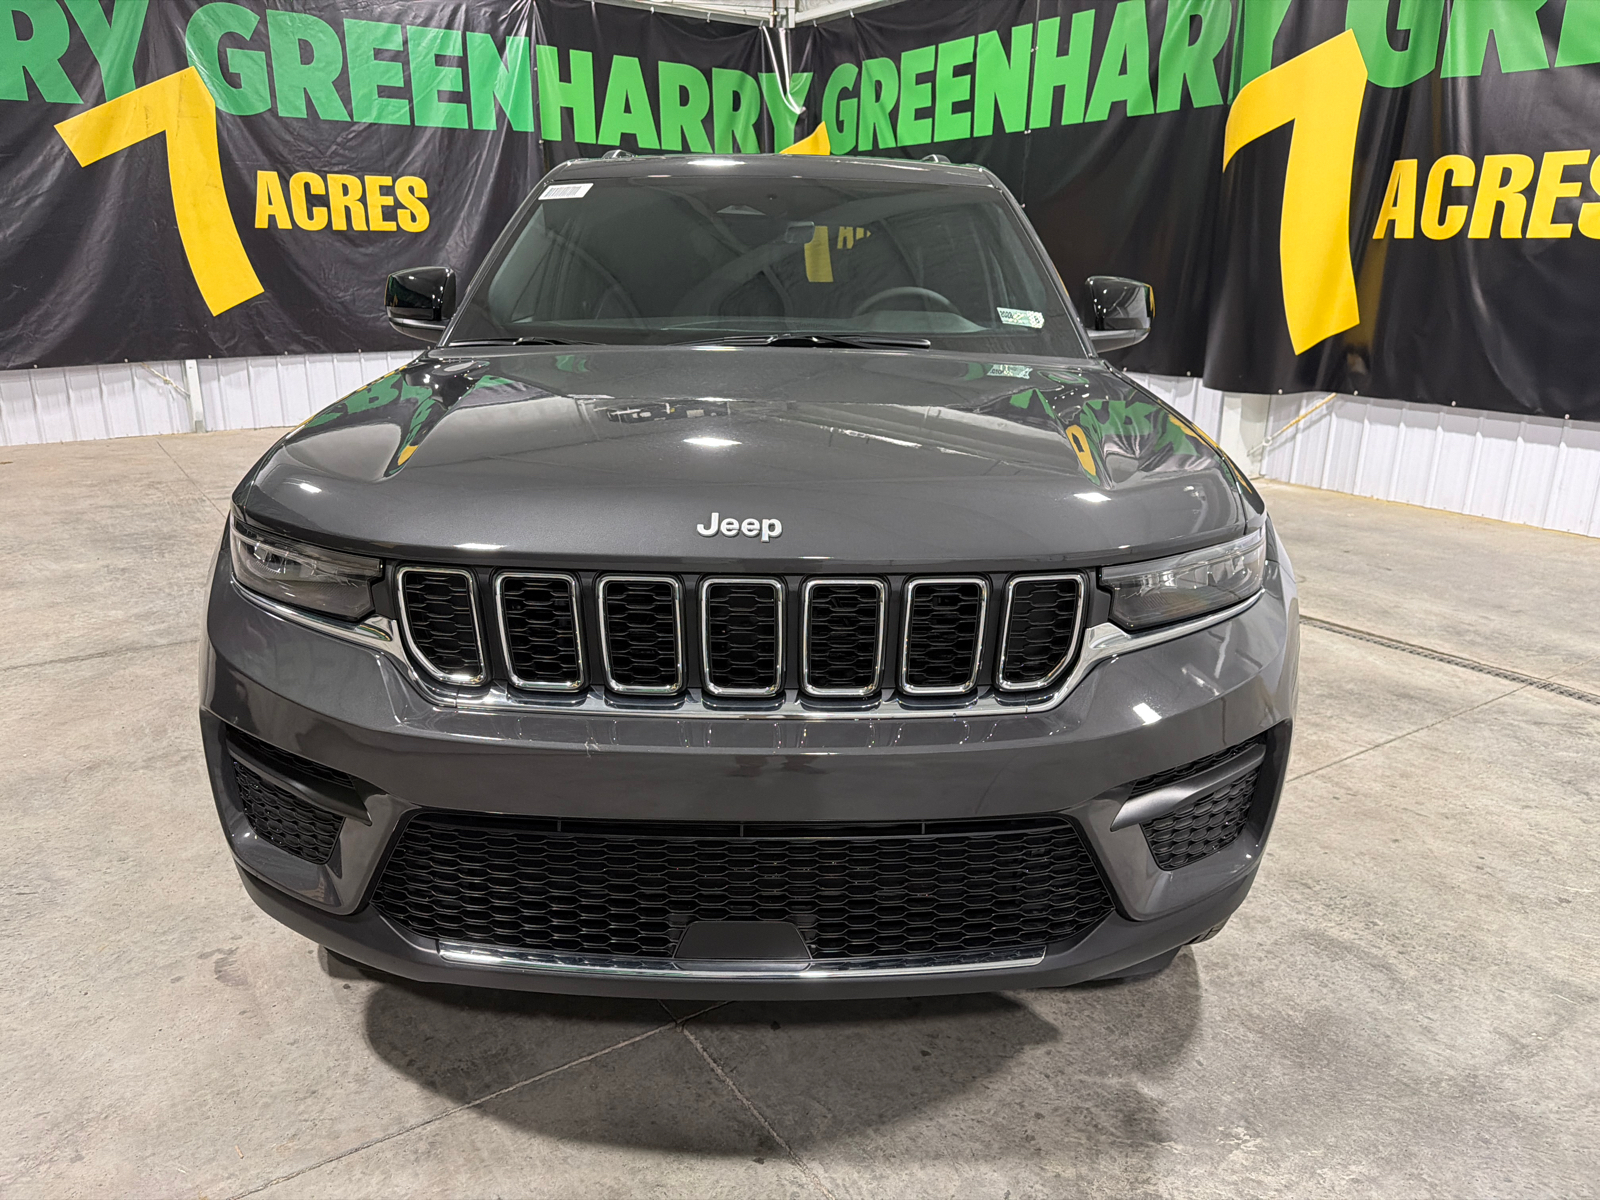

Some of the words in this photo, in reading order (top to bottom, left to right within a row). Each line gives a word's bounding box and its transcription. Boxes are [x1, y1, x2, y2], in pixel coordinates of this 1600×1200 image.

[186, 2, 535, 132] GREEN
[536, 45, 813, 154] HARRY
[821, 23, 1033, 155] GREEN
[54, 66, 264, 316] 7
[255, 170, 430, 232] ACRES
[1223, 28, 1368, 355] 7
[696, 512, 783, 543] Jeep
